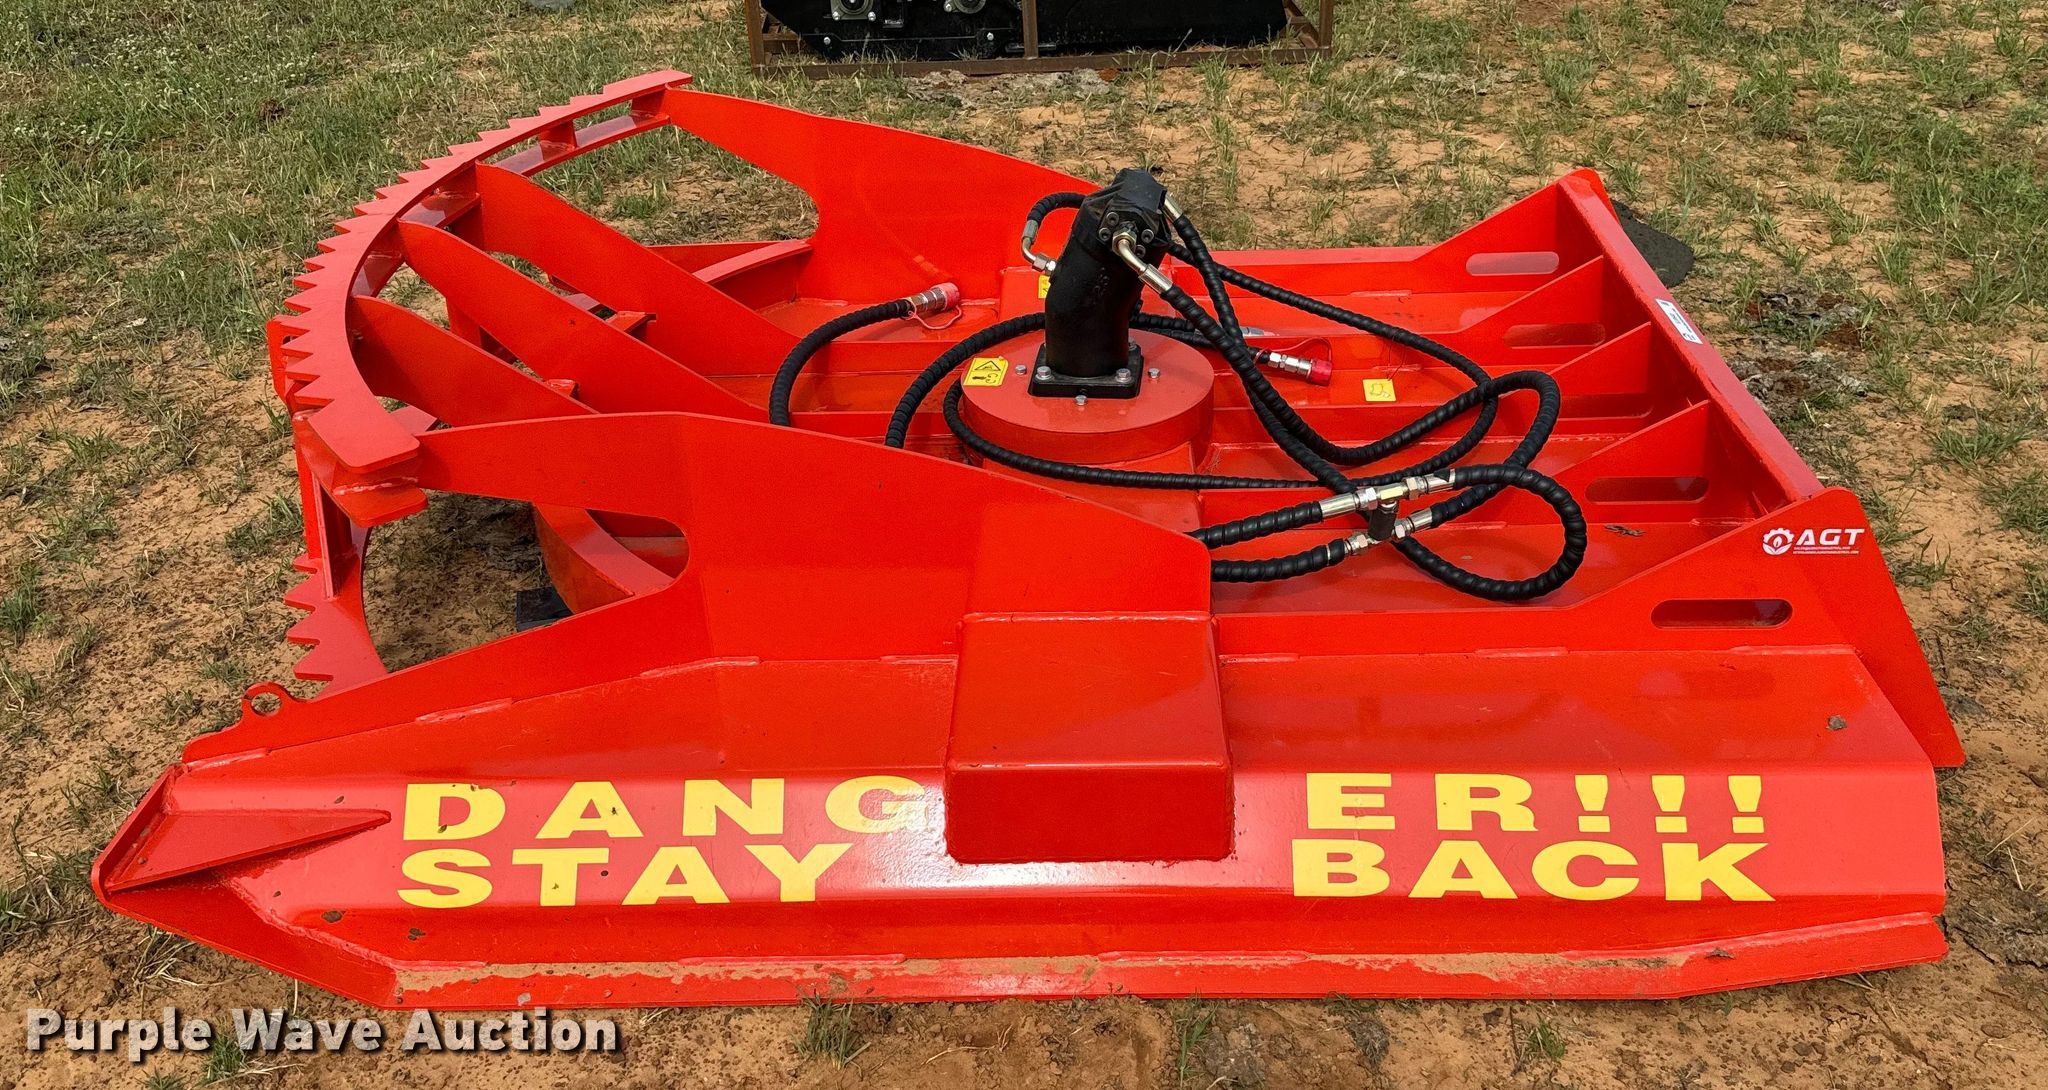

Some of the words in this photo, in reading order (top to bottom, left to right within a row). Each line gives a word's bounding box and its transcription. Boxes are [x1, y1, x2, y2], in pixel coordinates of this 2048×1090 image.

[1795, 528, 1865, 546] AGT
[403, 775, 928, 841] DANG
[1306, 773, 1765, 833] ER!!!
[397, 842, 853, 908] STAY
[1292, 839, 1776, 901] BACK
